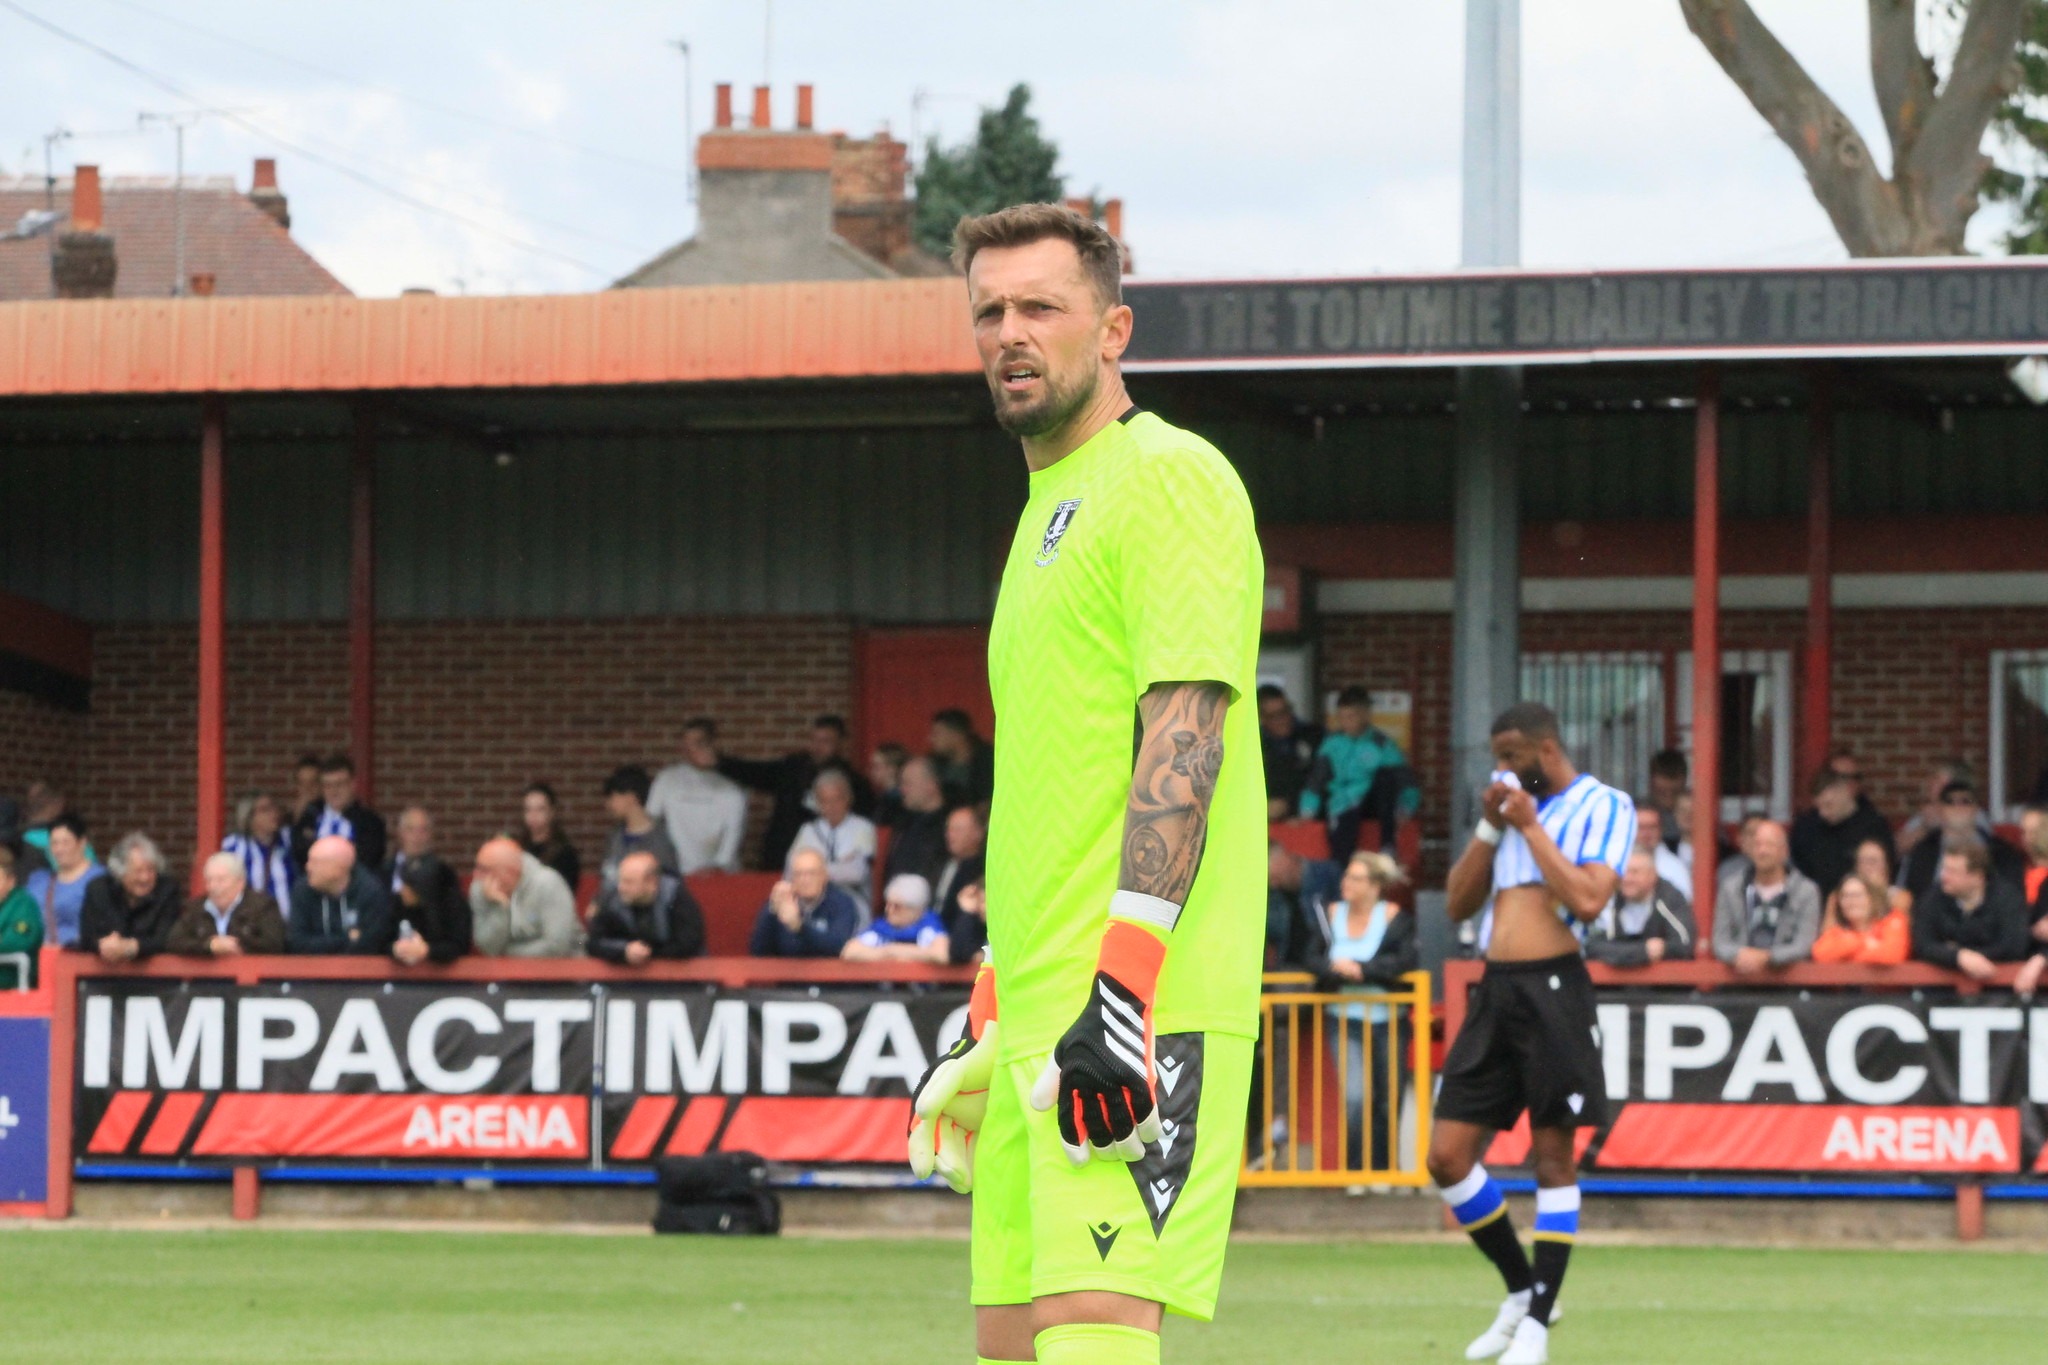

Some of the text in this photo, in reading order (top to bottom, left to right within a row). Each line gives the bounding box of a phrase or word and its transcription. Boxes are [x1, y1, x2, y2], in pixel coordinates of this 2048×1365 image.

[1180, 289, 1279, 352] THE
[1288, 284, 1504, 350] TOMMIE
[1512, 276, 1752, 346] BRADLEY
[83, 996, 593, 1093] IMPACT
[605, 1000, 970, 1095] IMPA
[1596, 1004, 2023, 1104] PACT
[402, 1104, 577, 1149] ARENA
[1822, 1115, 2009, 1163] ARENA
